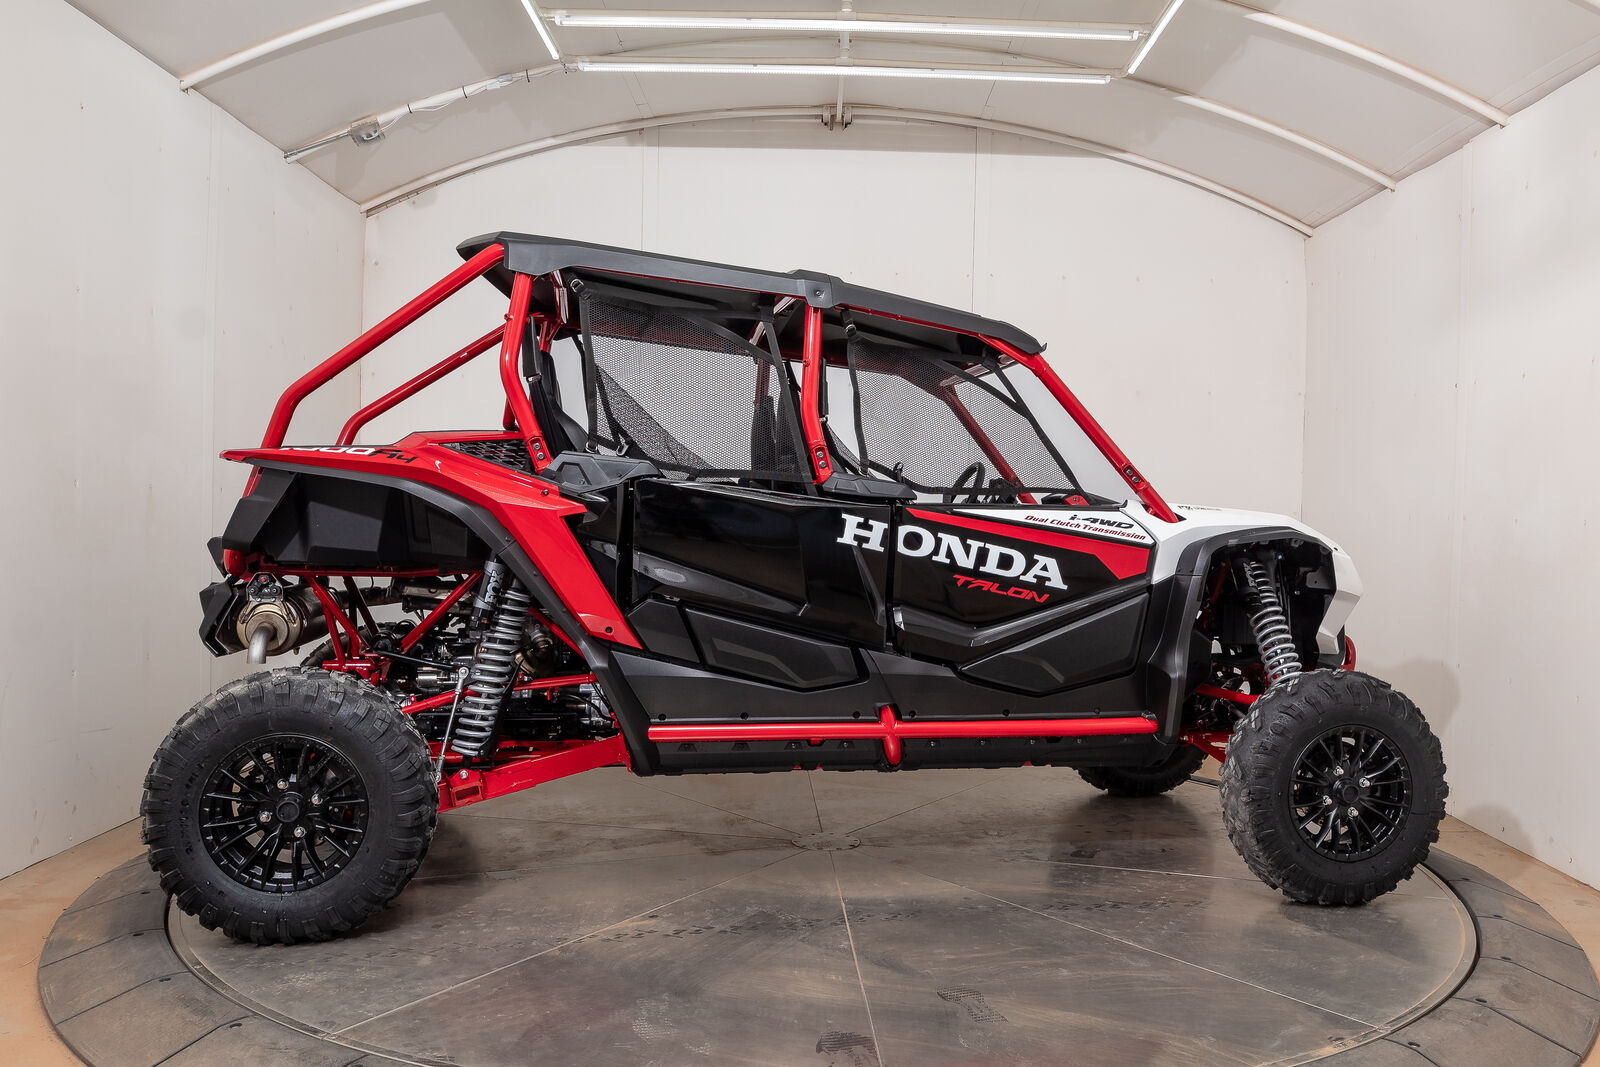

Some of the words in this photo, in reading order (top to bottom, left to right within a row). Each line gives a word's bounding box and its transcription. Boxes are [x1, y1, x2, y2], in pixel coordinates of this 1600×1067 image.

[1024, 515, 1048, 524] Dual
[1049, 518, 1081, 529] Clutch
[1082, 523, 1146, 541] Transmission
[1069, 514, 1135, 530] i-4WD
[836, 513, 1068, 590] HONDA
[952, 574, 1050, 603] TALON
